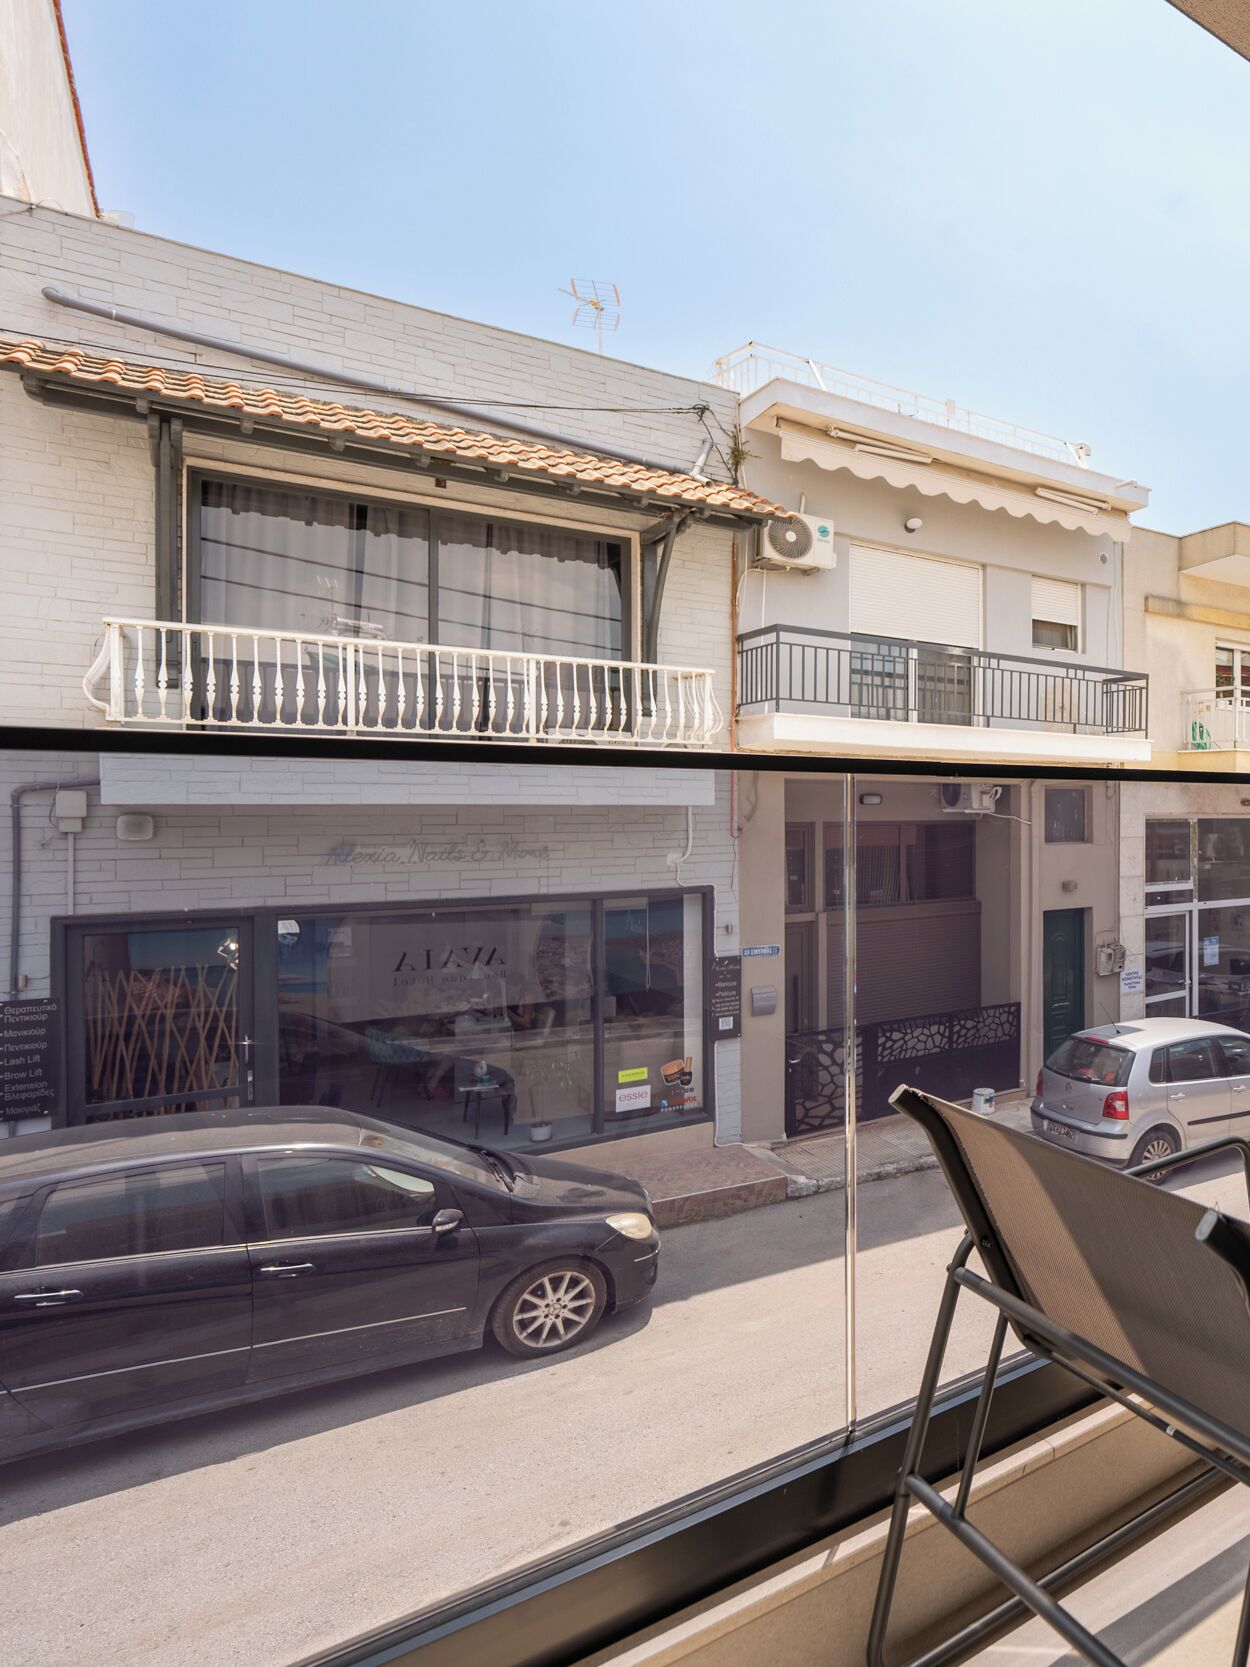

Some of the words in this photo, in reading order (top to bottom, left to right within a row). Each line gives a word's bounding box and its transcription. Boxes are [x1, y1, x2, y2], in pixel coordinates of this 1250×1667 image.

[4, 1057, 25, 1066] Lash
[28, 1055, 41, 1063] Lift
[4, 1071, 27, 1080] Brow
[29, 1069, 42, 1077] Lift
[619, 1090, 648, 1102] essie
